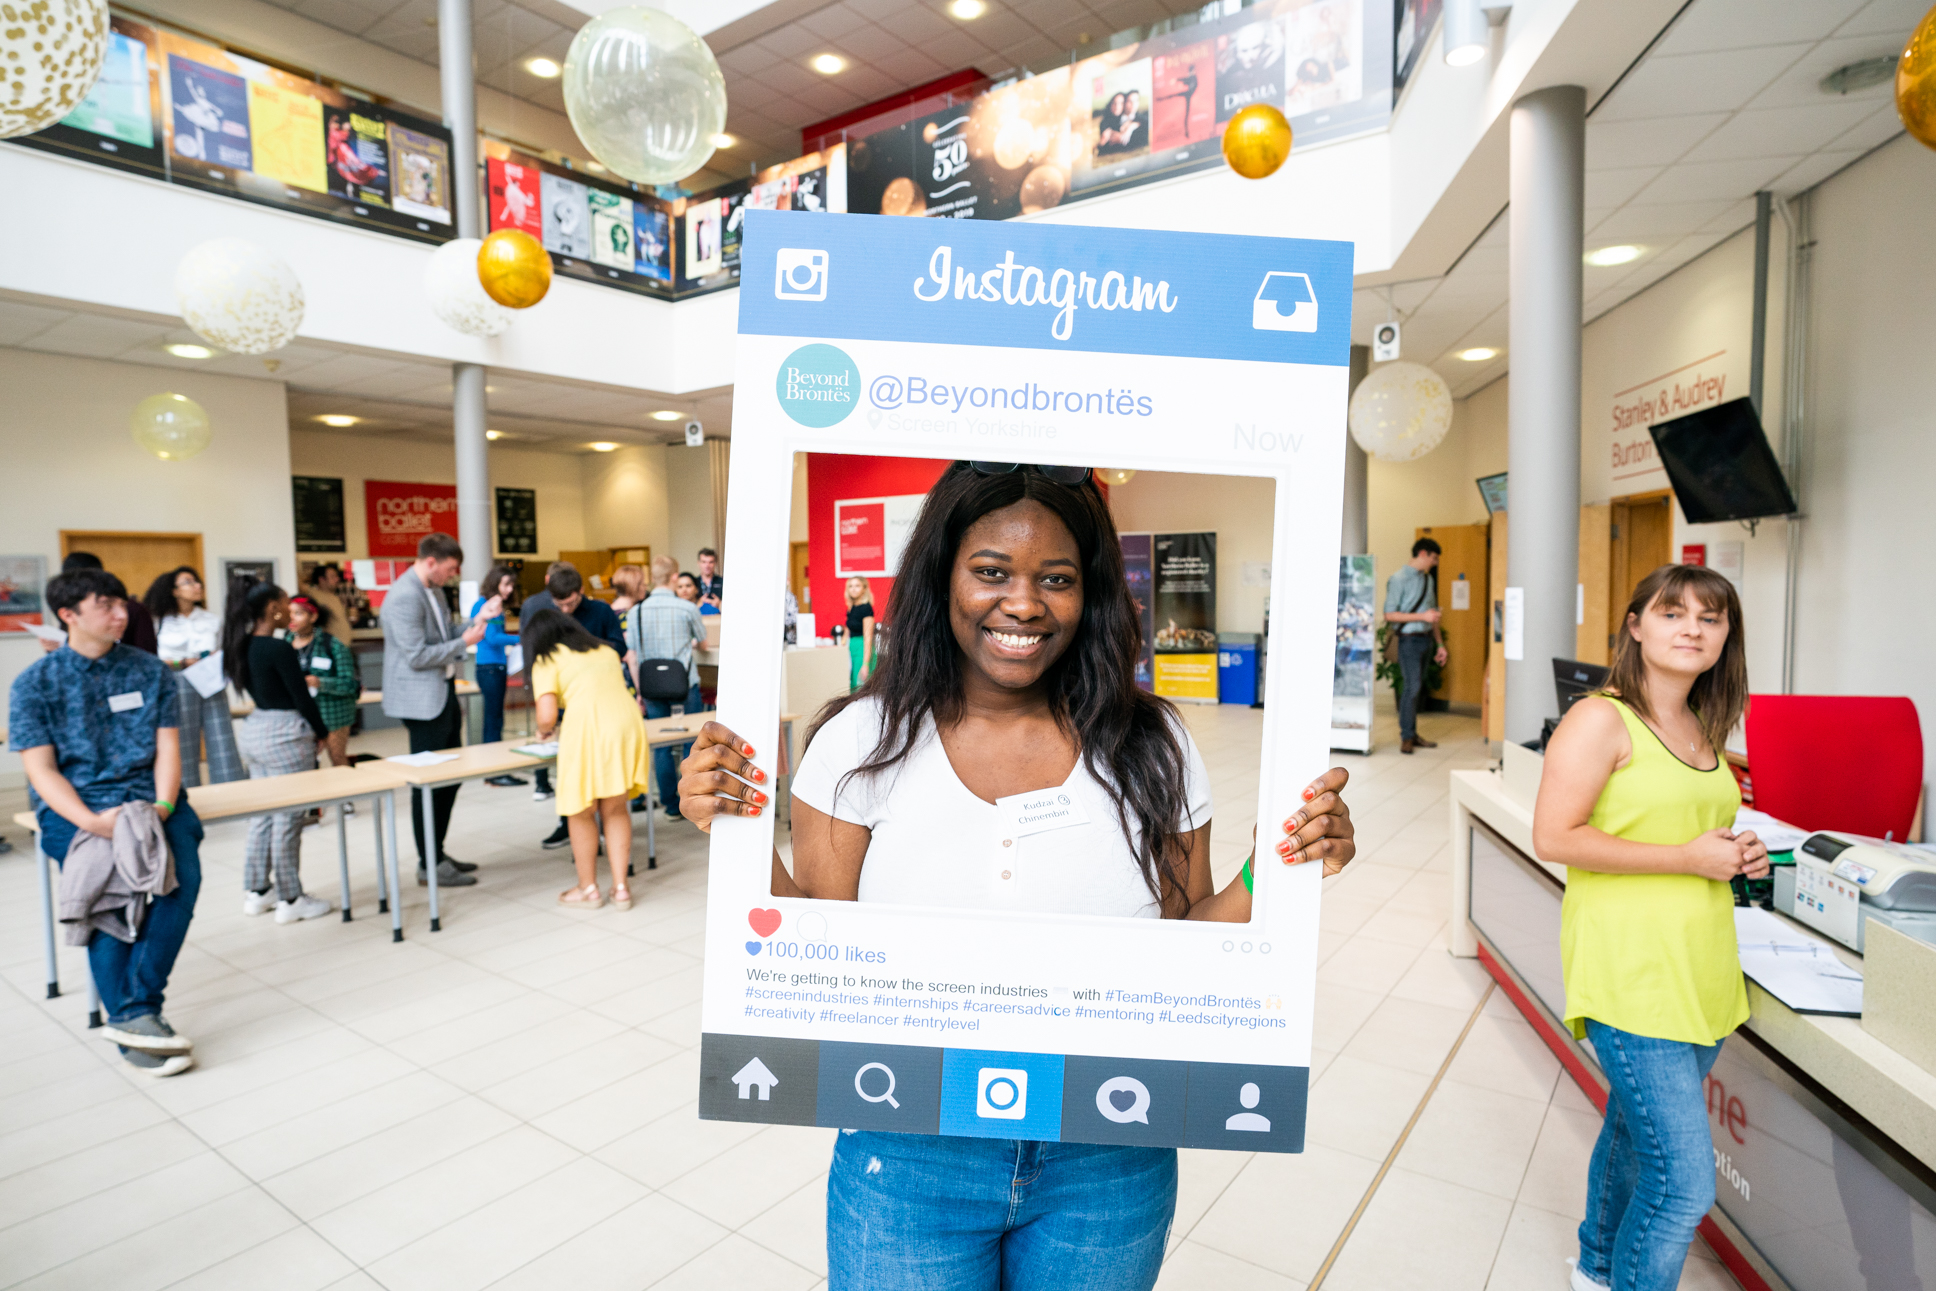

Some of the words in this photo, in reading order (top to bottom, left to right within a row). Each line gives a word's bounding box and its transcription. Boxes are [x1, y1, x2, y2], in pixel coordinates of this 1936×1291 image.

[932, 139, 967, 182] 50
[913, 245, 1178, 340] Instagram
[786, 367, 849, 387] Beyond
[785, 383, 850, 402] Brontës
[869, 375, 1153, 417] @Beyondbrontës
[1612, 396, 1657, 432] Stanley
[1659, 389, 1669, 417] &
[1671, 374, 1726, 413] Audrey
[887, 413, 957, 434] Screen
[965, 417, 1057, 439] Yorkshire
[1233, 423, 1304, 453] Now
[1612, 440, 1652, 468] Burton
[379, 513, 432, 530] ballet
[1018, 809, 1069, 824] Chinembiri
[1023, 799, 1054, 811] Kudzai
[765, 941, 839, 962] 100,000
[845, 946, 887, 963] likes
[746, 968, 787, 982] We're
[791, 972, 838, 987] getting
[843, 974, 856, 987] to
[860, 975, 897, 990] know
[902, 978, 924, 991] the
[928, 981, 975, 994] screen
[980, 982, 1048, 998] industries
[1073, 988, 1101, 1001] with
[1105, 989, 1261, 1009] #TeamBeyondBrontës
[744, 1005, 815, 1023] #creativity
[820, 1009, 899, 1026] #freelancer
[903, 1014, 980, 1031] #entrylevel
[745, 986, 869, 1005] #screenindustries
[873, 996, 959, 1012] #internships
[963, 999, 1071, 1017] #careersadvice
[1075, 1005, 1154, 1024] #mentoring
[1159, 1010, 1286, 1029] #Leedscityregions
